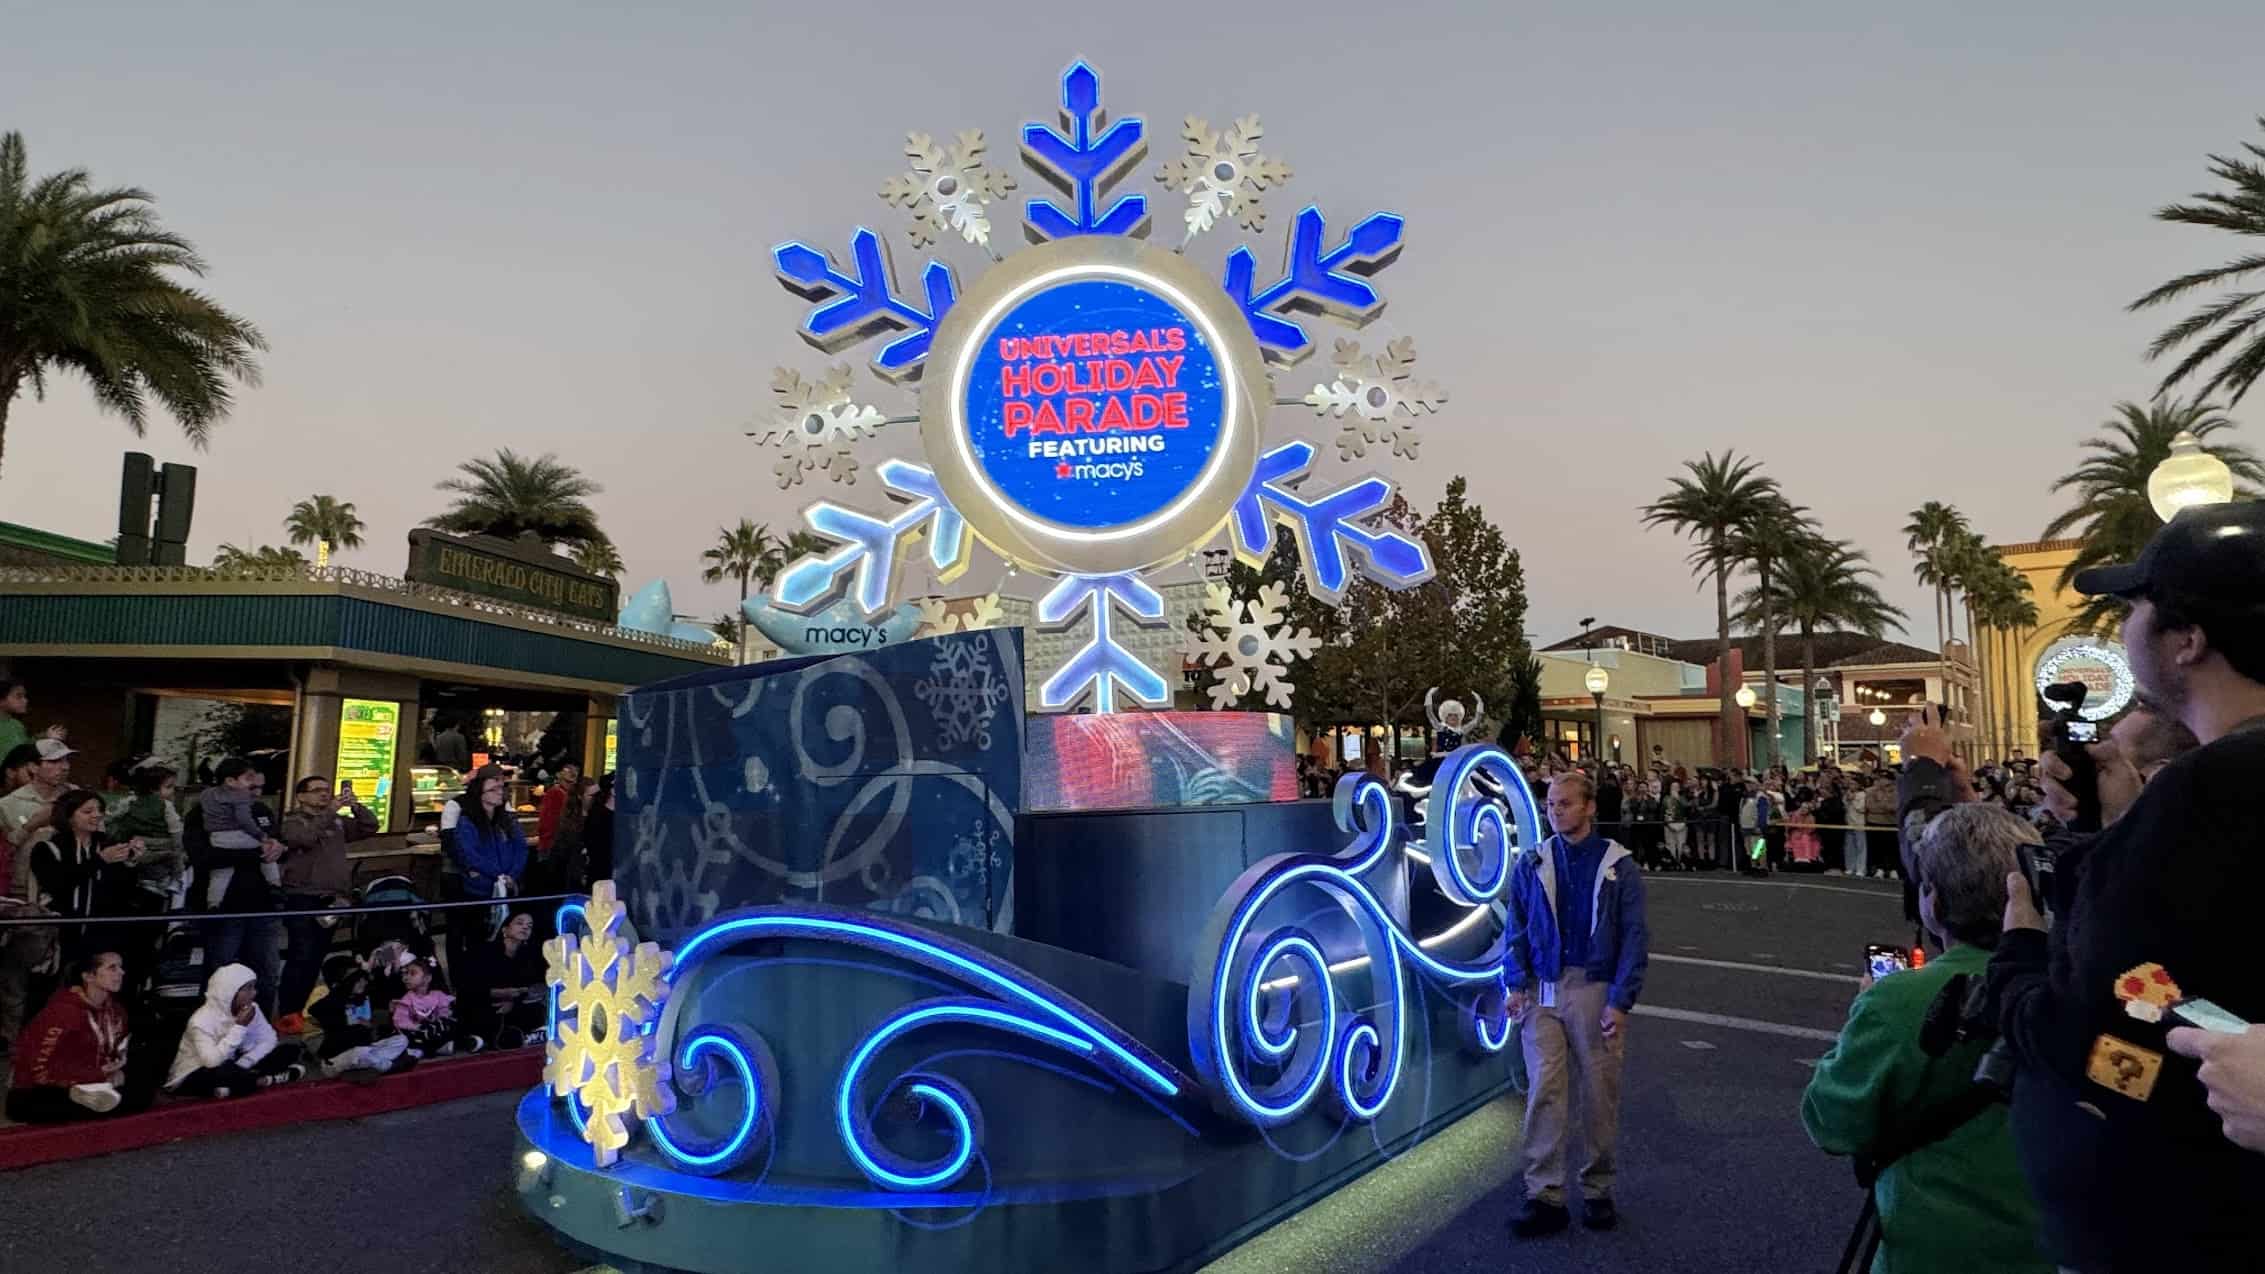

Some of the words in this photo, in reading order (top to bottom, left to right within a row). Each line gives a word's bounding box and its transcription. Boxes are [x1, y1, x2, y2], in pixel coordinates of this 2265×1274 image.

[1000, 328, 1186, 360] UNIVERSAL'S
[1002, 356, 1185, 397] HOLIDAY
[1004, 392, 1189, 438] PARADE
[1028, 435, 1165, 458] FEATURING
[1075, 461, 1144, 481] macy's
[439, 549, 526, 590] EMERALD
[529, 570, 563, 605] CITY
[569, 580, 604, 608] EATS
[805, 627, 888, 647] macy's
